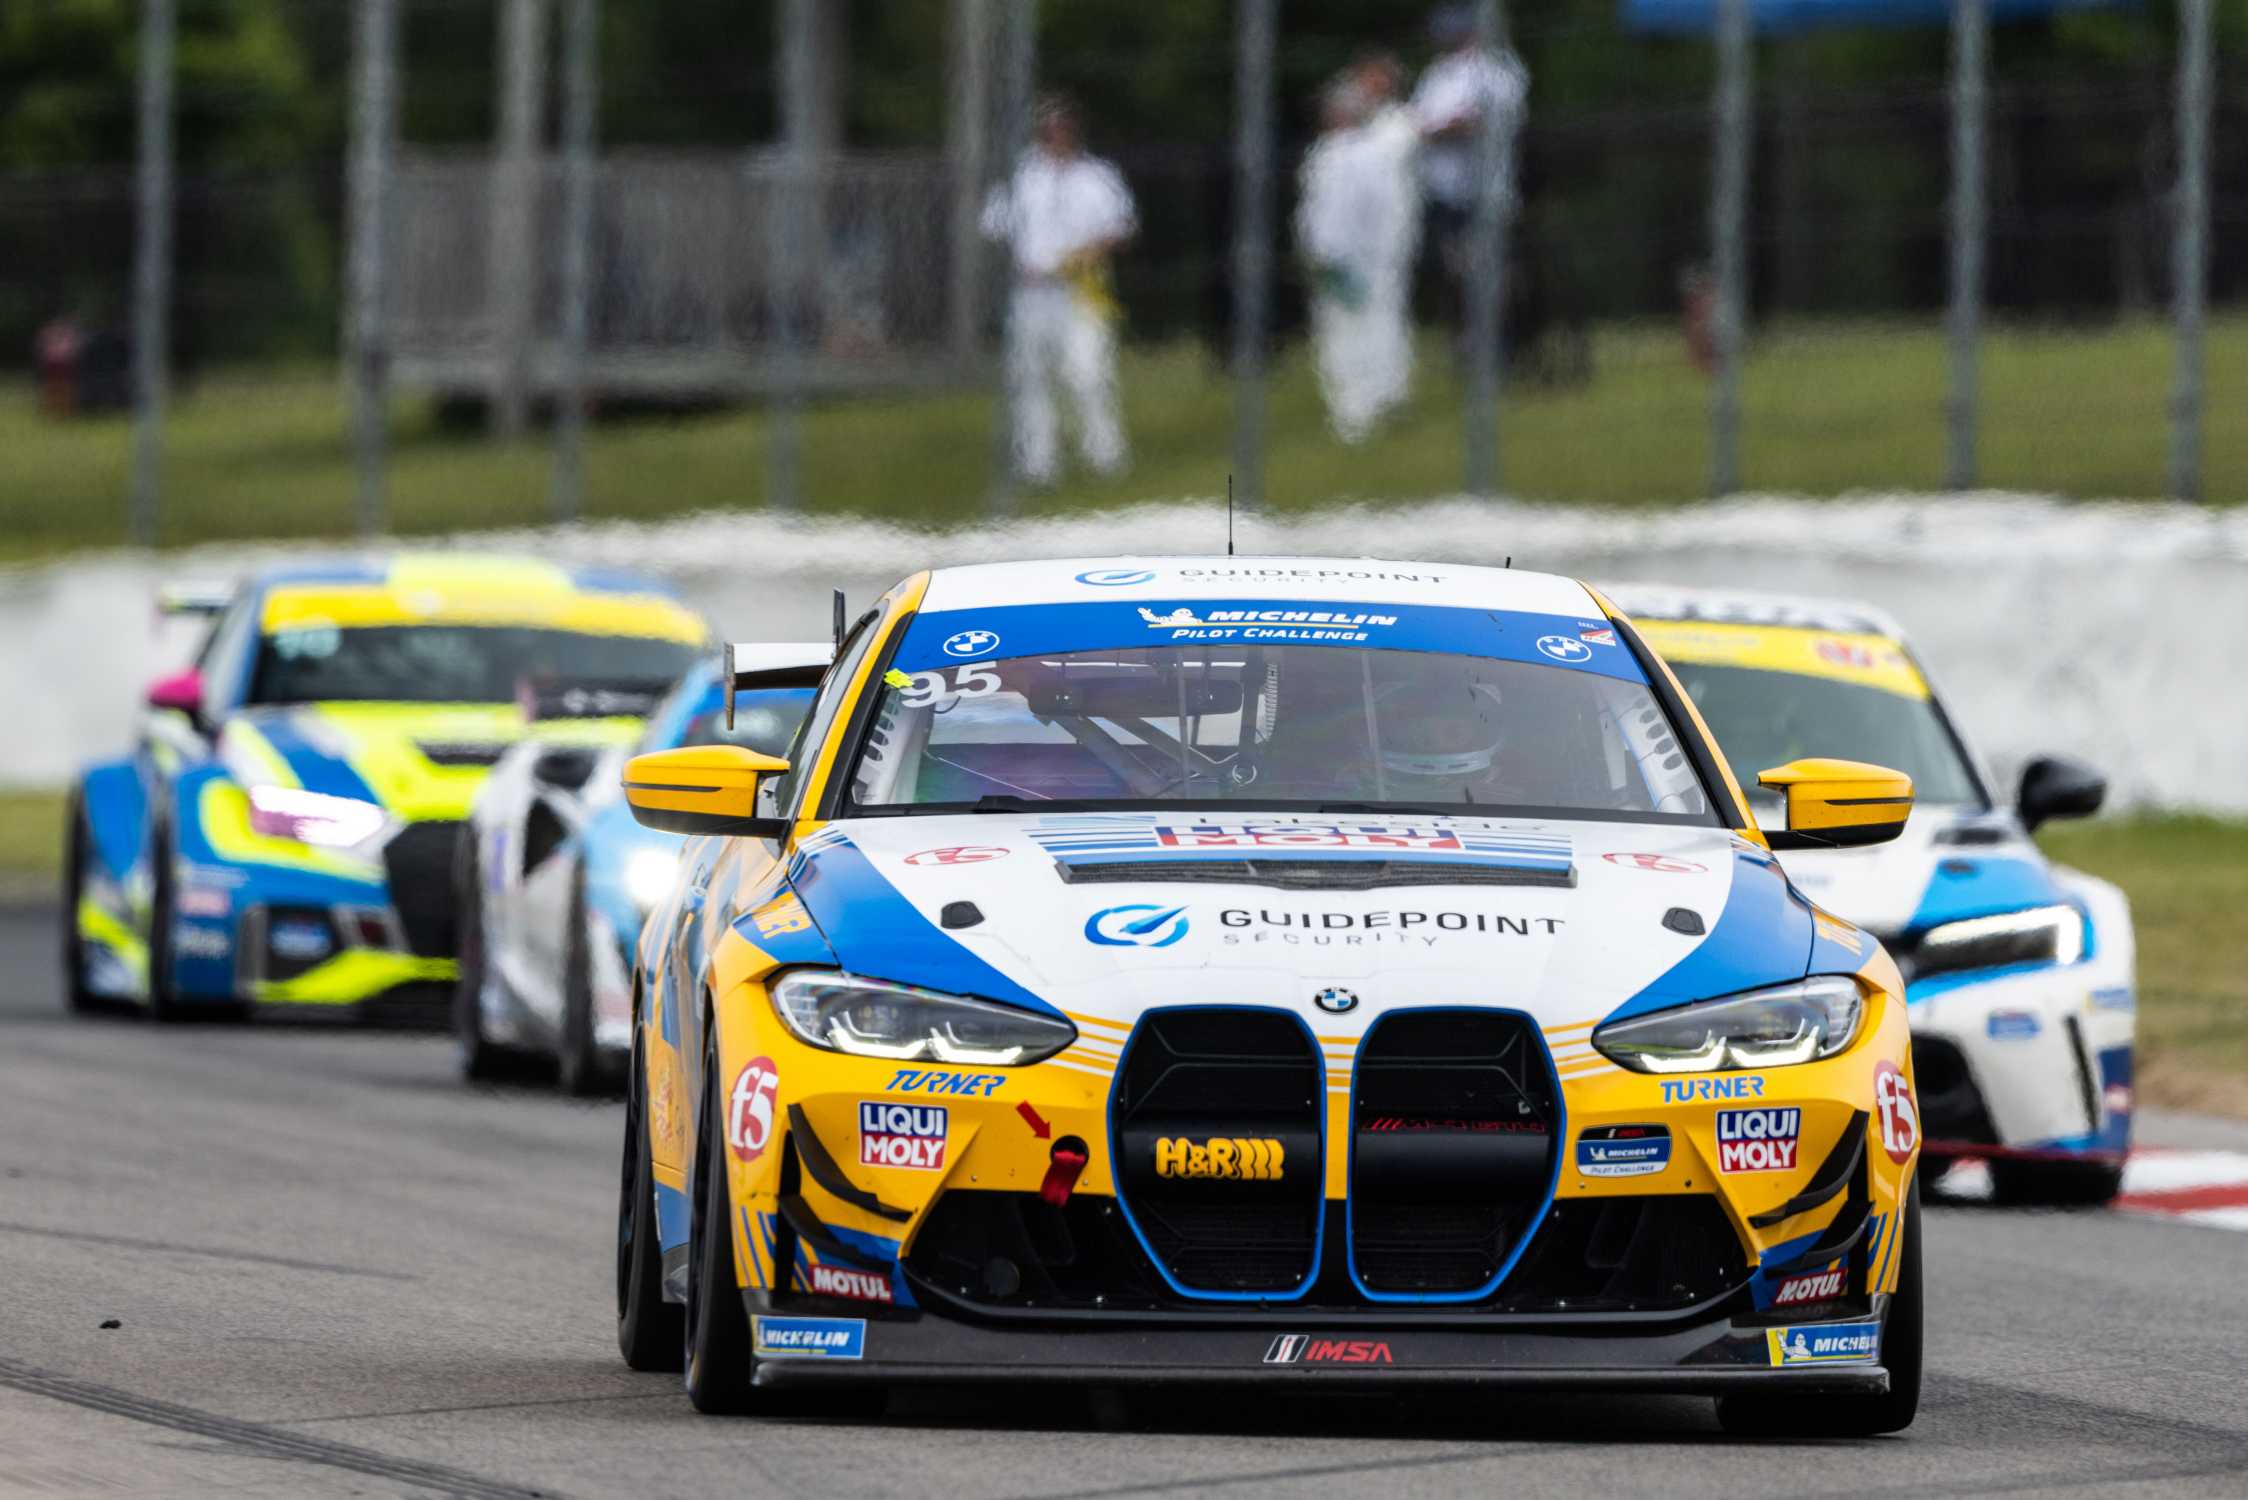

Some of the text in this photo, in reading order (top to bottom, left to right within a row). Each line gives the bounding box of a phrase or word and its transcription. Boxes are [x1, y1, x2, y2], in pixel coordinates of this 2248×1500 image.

[1179, 569, 1448, 584] GUIDEPOINT
[1207, 610, 1398, 627] MICHELIN
[1171, 627, 1369, 641] PILOT CHALLENGE
[899, 661, 1003, 708] 95
[1176, 833, 1451, 848] MOLY
[1219, 908, 1566, 936] GUIDEPOINT
[1222, 930, 1440, 948] SECURITY
[885, 1069, 1007, 1097] TURNER
[1660, 1075, 1765, 1103] TURNER
[730, 1065, 779, 1151] f5
[863, 1104, 945, 1137] LIQUI
[1720, 1109, 1798, 1139] LIQUI
[863, 1135, 945, 1167] MOLY
[1722, 1139, 1796, 1170] MOLY
[813, 1266, 892, 1300] MOTUL
[1775, 1271, 1842, 1304] MOTUL
[1304, 1340, 1393, 1363] IMSA
